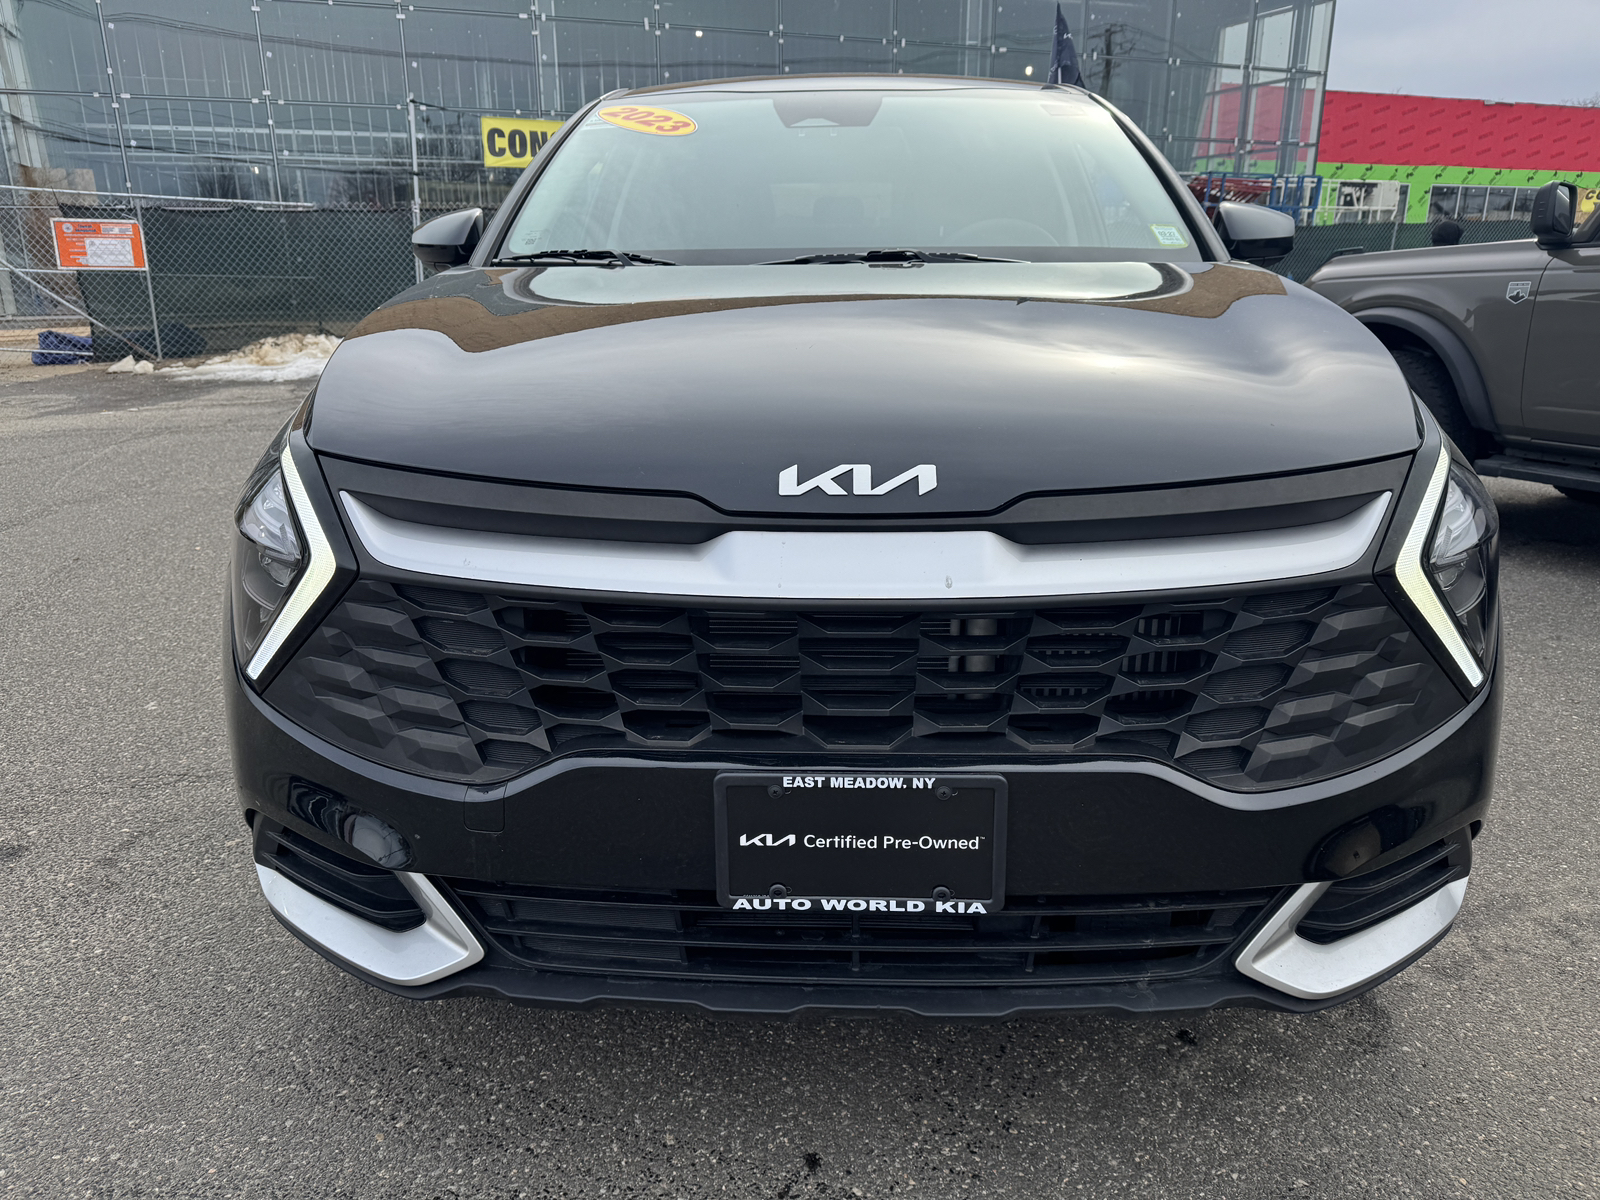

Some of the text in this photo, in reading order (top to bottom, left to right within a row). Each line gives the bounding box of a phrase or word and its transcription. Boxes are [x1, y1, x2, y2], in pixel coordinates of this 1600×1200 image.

[601, 107, 691, 132] 2023
[486, 127, 556, 158] CON
[778, 464, 938, 496] KIA
[782, 776, 825, 788] EAST
[912, 777, 936, 789] NY
[739, 833, 796, 847] KIA
[803, 835, 877, 849] Certified
[732, 898, 987, 914] AUTO WORLD KIA
